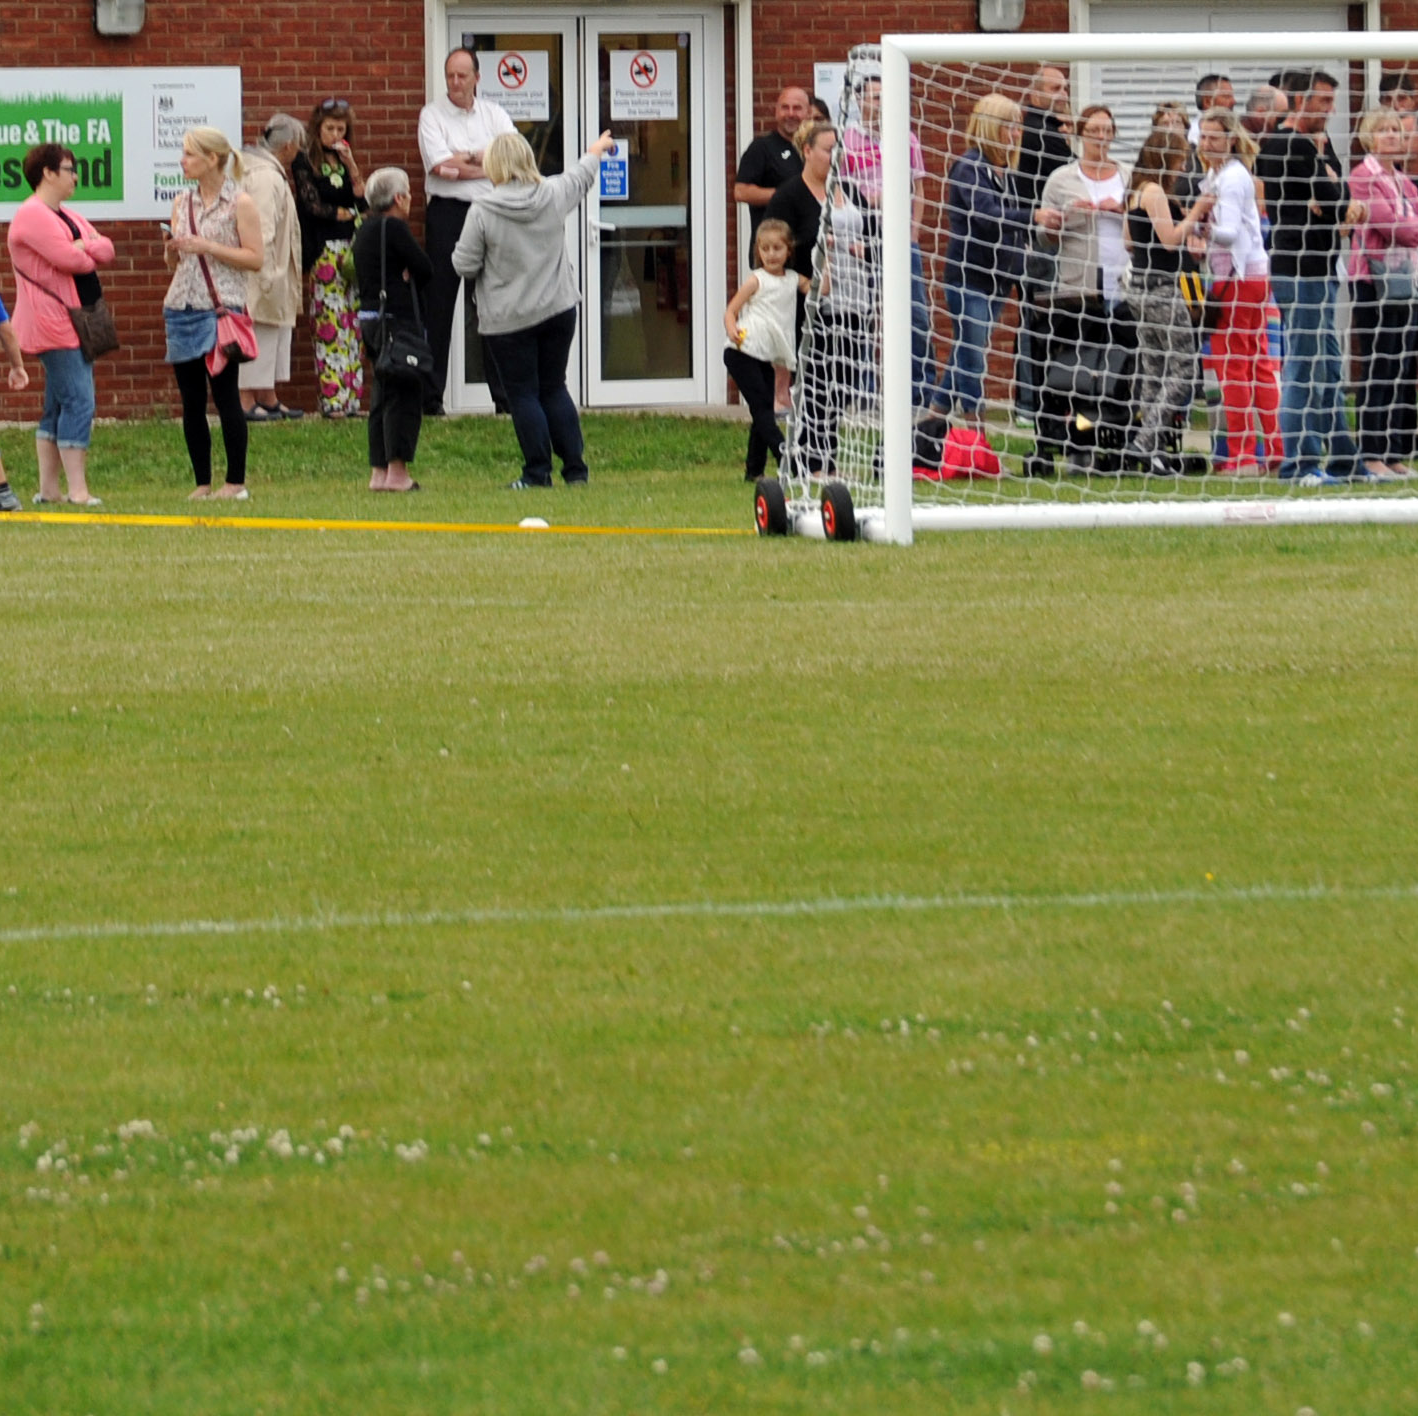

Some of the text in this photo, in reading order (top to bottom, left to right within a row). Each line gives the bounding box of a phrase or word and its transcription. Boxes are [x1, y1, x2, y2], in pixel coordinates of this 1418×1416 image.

[157, 114, 208, 125] Department
[24, 118, 41, 145] &
[42, 118, 81, 145] The
[86, 118, 112, 144] FA
